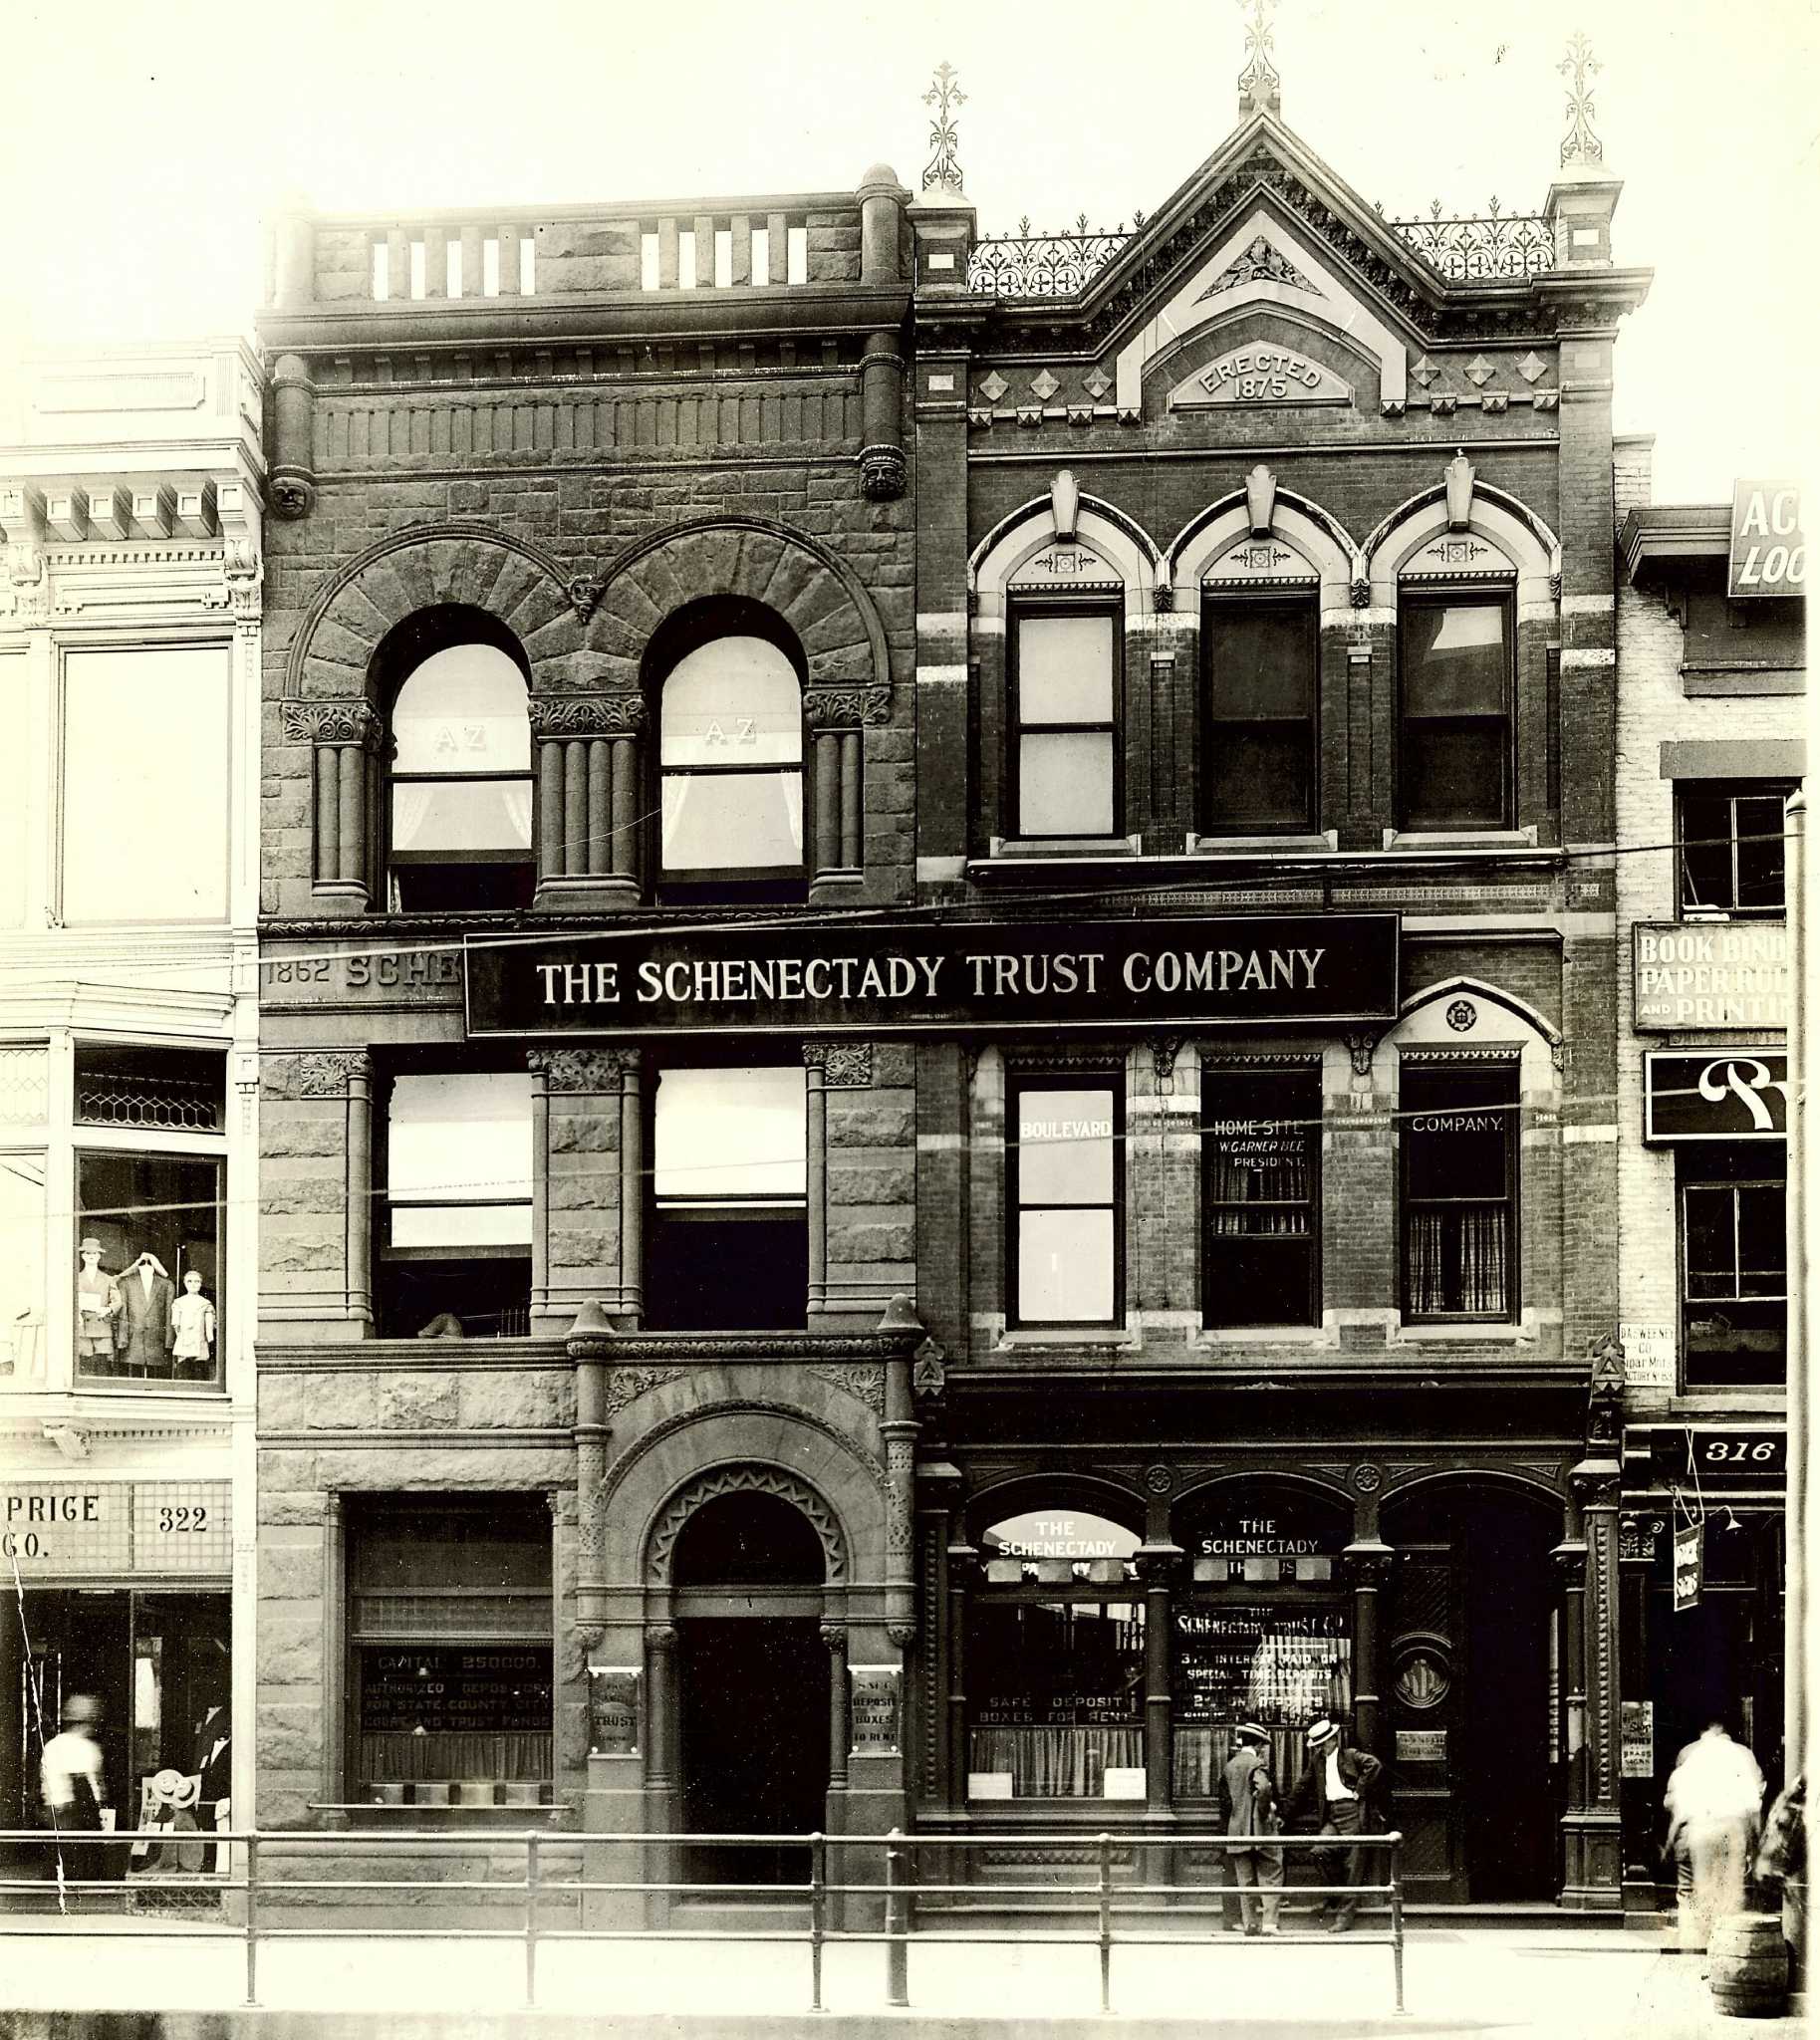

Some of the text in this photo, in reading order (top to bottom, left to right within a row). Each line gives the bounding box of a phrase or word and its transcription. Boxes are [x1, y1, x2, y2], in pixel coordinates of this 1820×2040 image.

[1199, 354, 1322, 393] ERECTED
[1235, 377, 1287, 399] 1875
[1640, 935, 1714, 963] BOOK
[267, 952, 331, 984] 1862
[536, 948, 1327, 1005] THE SCHENECTADY TRUST COMPANY
[1641, 967, 1729, 995] PAPER
[1641, 1004, 1671, 1015] AND
[1020, 1121, 1112, 1139] BOULEVARD
[1214, 1120, 1304, 1136] HOME SITE
[1705, 1441, 1776, 1461] 316
[159, 1506, 207, 1532] 322
[1036, 1521, 1075, 1536] THE
[1239, 1520, 1276, 1534] THE
[998, 1542, 1117, 1557] SCHENECTADY
[1201, 1540, 1319, 1554] SCHENECTADY
[1282, 1654, 1312, 1664] PAID
[1320, 1654, 1338, 1664] ON
[1186, 1669, 1234, 1679] SPECIAL
[1277, 1669, 1332, 1679] DEPOSITS
[989, 1696, 1124, 1707] SAFE DEPOSIT
[595, 1715, 638, 1727] TRUST
[855, 1714, 895, 1724] BOXES
[979, 1711, 1034, 1722] BOXES
[1047, 1711, 1076, 1722] FOR
